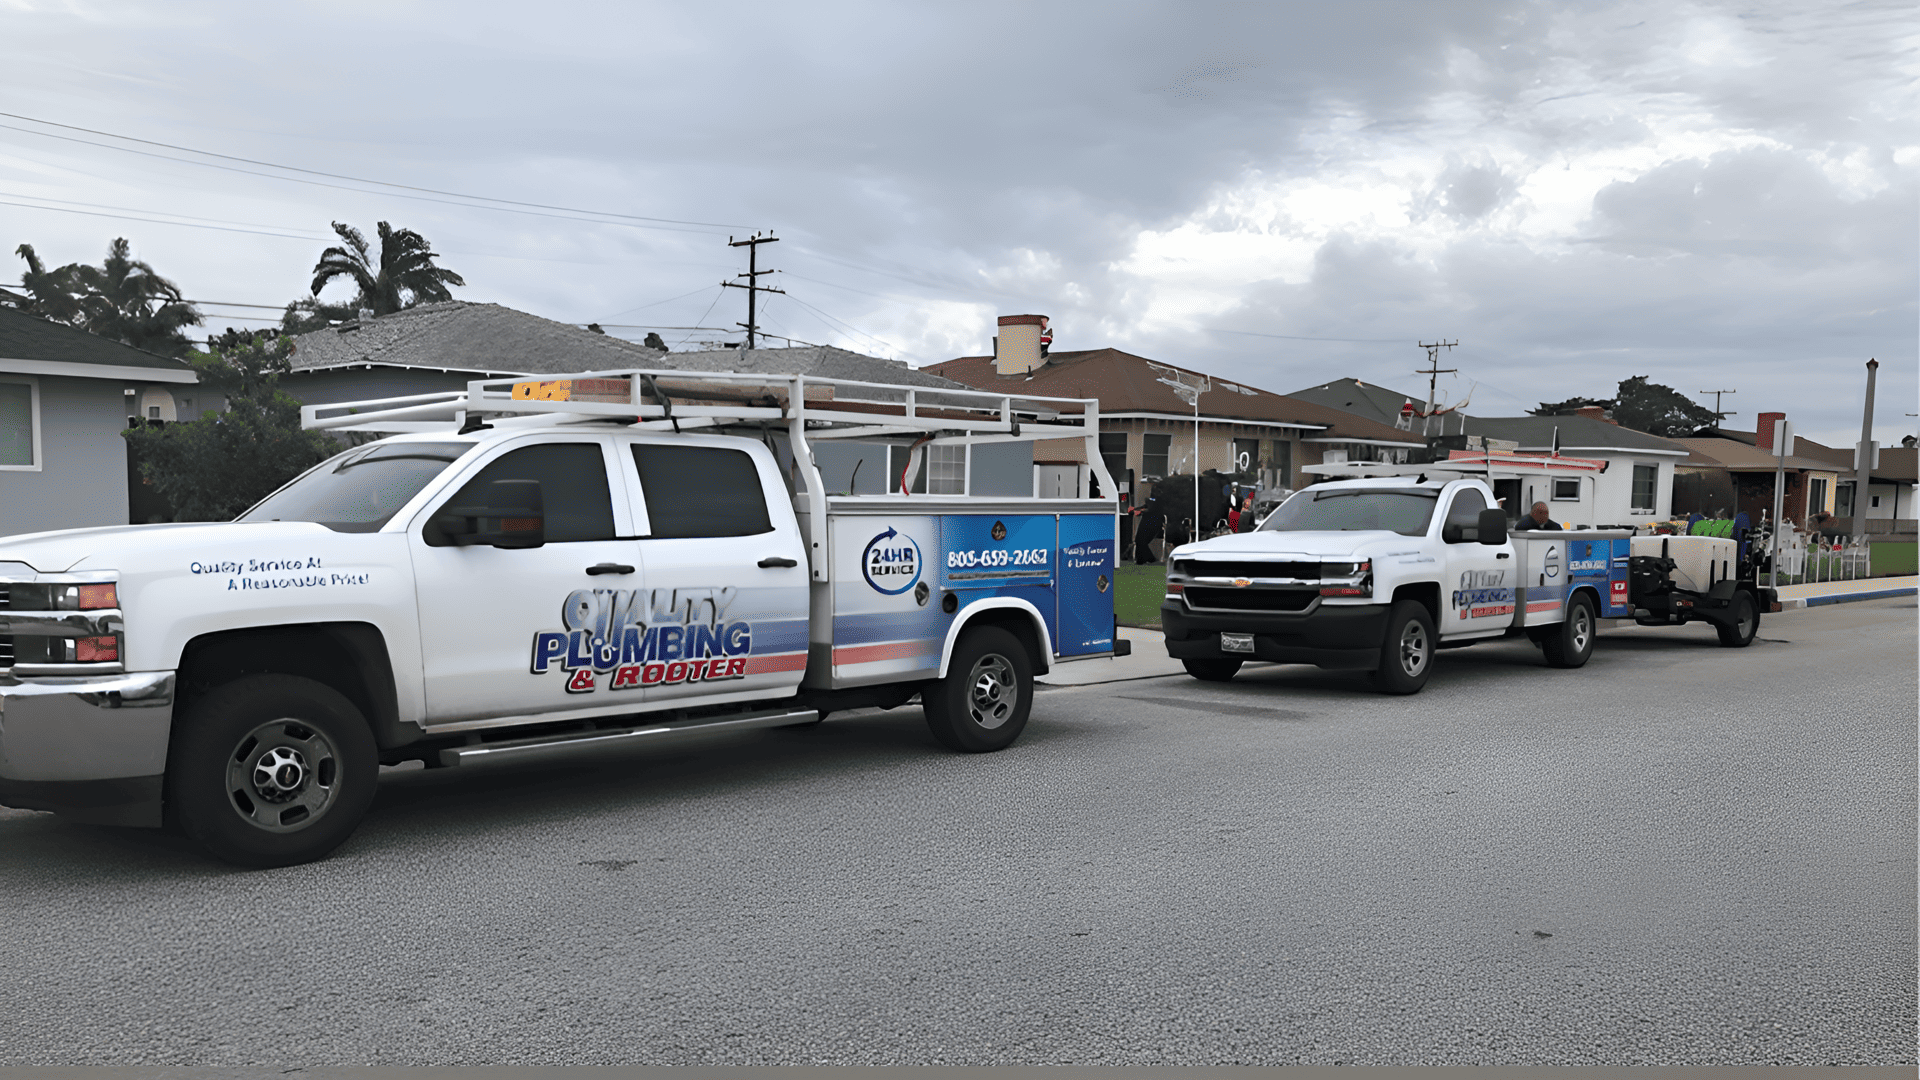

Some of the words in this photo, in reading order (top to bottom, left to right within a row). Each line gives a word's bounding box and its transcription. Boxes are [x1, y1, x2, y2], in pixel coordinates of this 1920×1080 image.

[228, 579, 237, 590] A
[562, 586, 737, 634] QUALITY
[531, 620, 752, 674] PLUMBING
[565, 667, 595, 693] &
[610, 657, 748, 690] ROOTER
